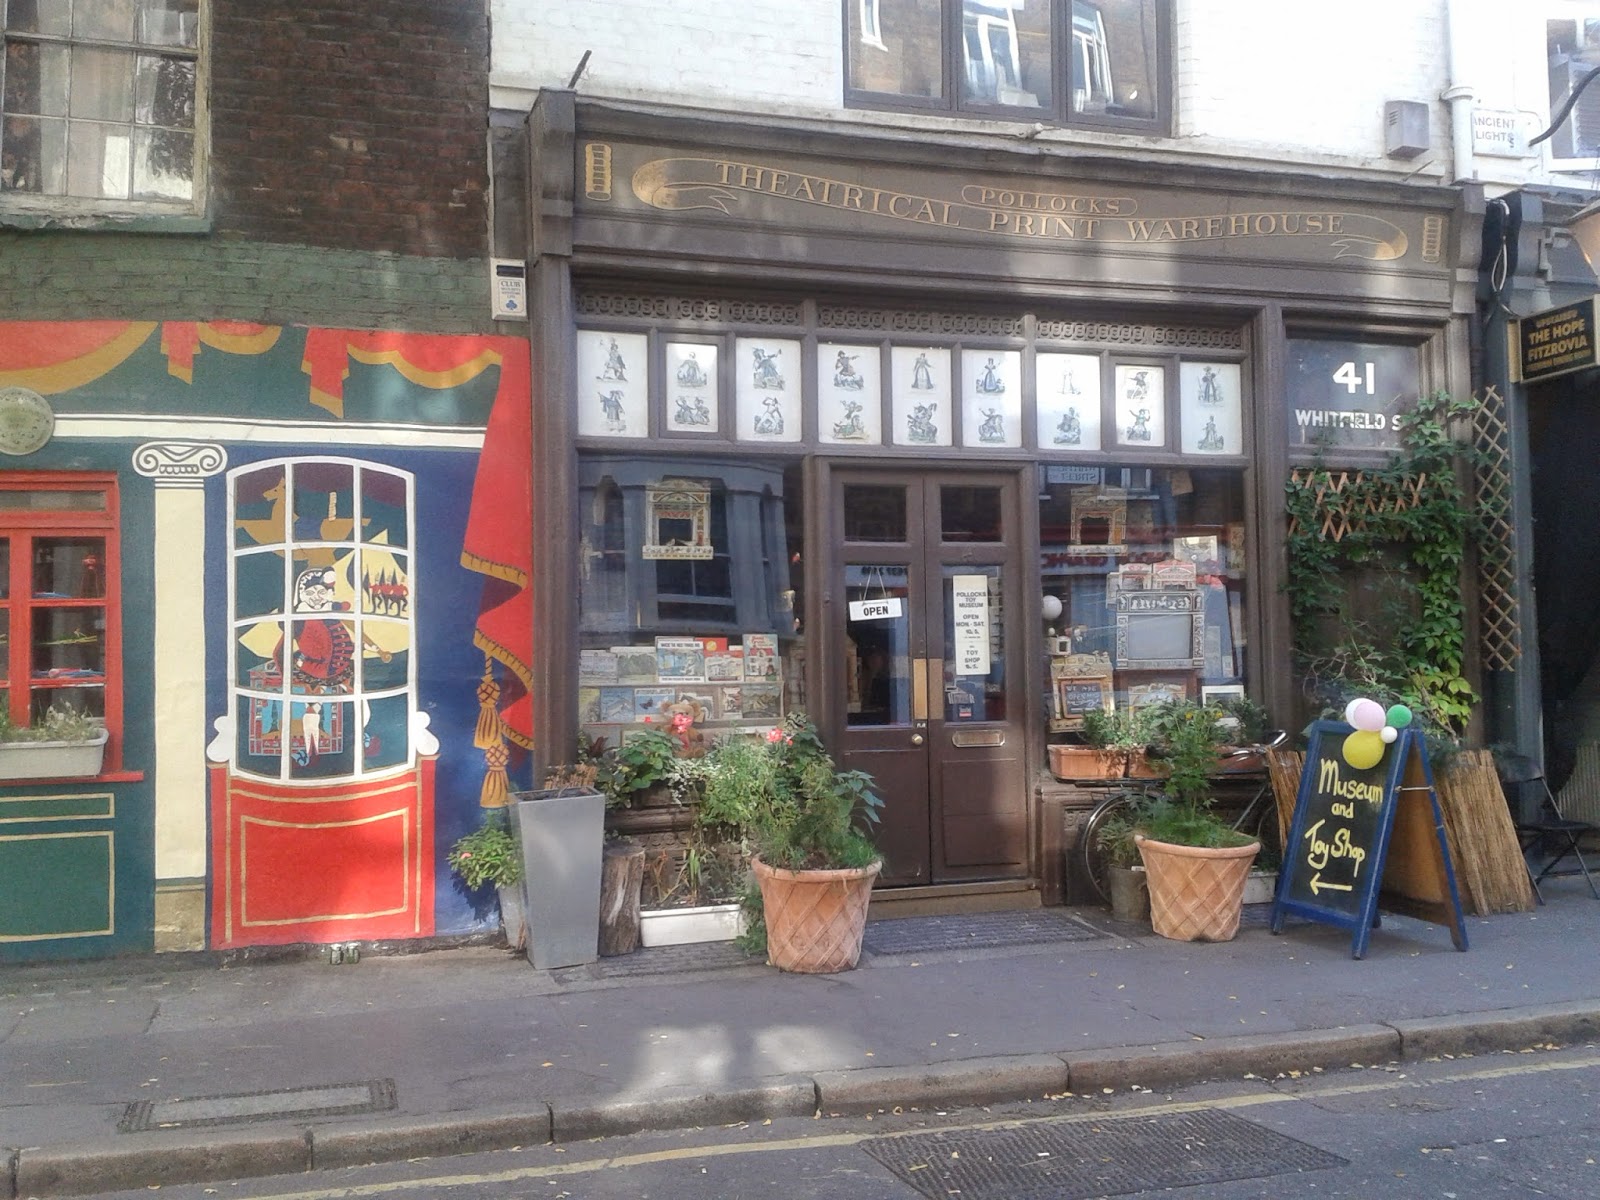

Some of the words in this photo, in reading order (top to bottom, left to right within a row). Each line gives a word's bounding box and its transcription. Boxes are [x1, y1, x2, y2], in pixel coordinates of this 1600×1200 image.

[715, 162, 960, 227] THEATRICAL
[988, 211, 1101, 240] PRINT
[1126, 212, 1345, 241] WAREHOUSE
[979, 187, 1121, 215] POLLOCKS
[1529, 328, 1550, 345] THE
[1552, 318, 1585, 338] HOPE
[1528, 335, 1587, 361] FITZROVIA
[1332, 362, 1375, 394] 41
[1295, 409, 1386, 430] WHITFIELD
[1391, 414, 1402, 430] S
[863, 606, 888, 616] OPEN
[1318, 758, 1383, 803] Museum
[1331, 802, 1354, 818] and
[1304, 819, 1329, 869] Toy
[1330, 828, 1366, 878] Shop
